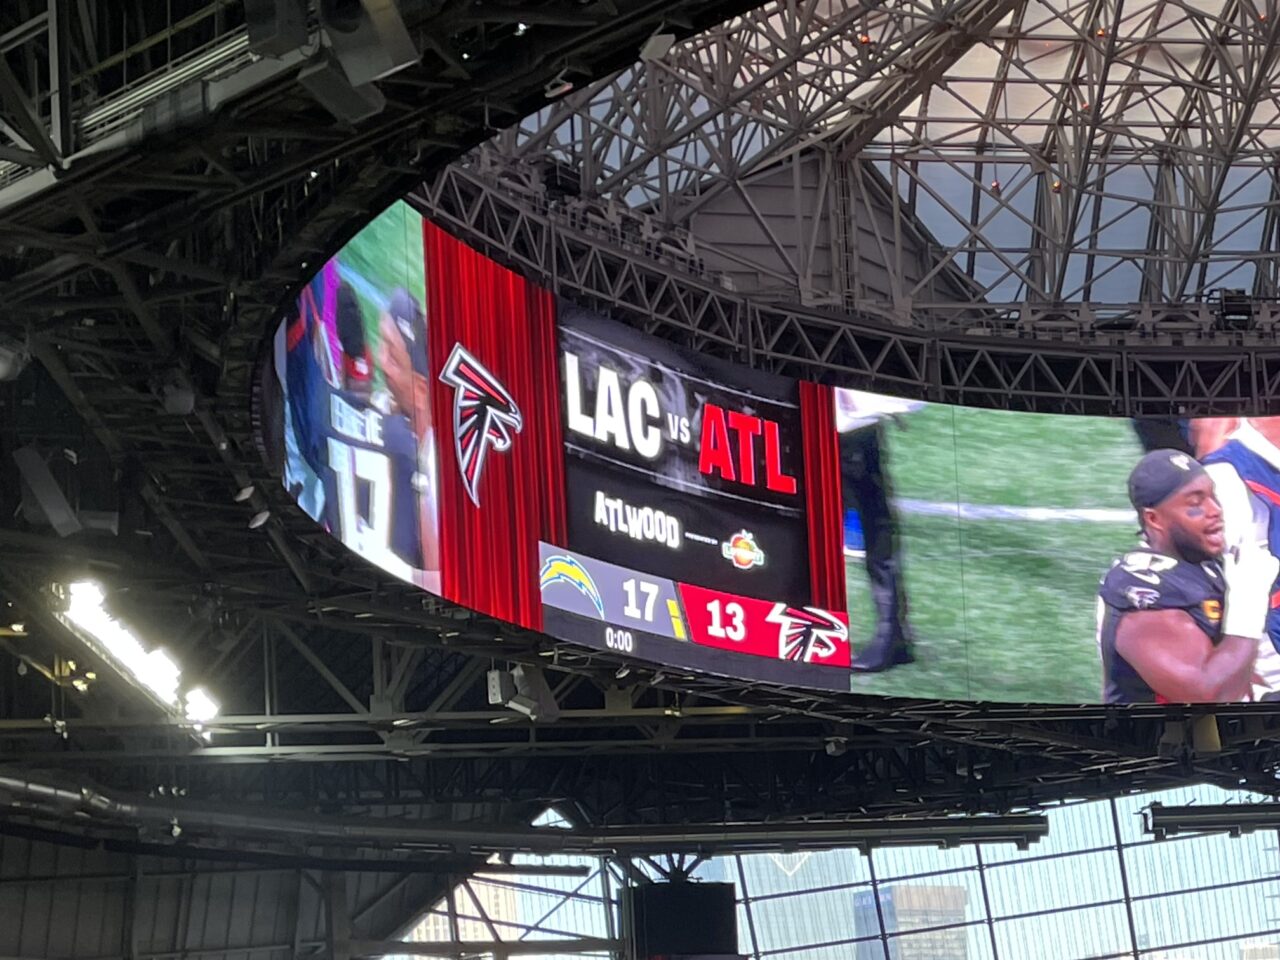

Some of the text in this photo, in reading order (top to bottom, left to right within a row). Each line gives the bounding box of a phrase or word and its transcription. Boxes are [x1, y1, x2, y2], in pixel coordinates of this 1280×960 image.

[564, 351, 797, 494] LAC VS ATL
[594, 491, 680, 549] ATLWOOD
[606, 627, 633, 652] 0:00
[622, 579, 746, 641] 17 13
